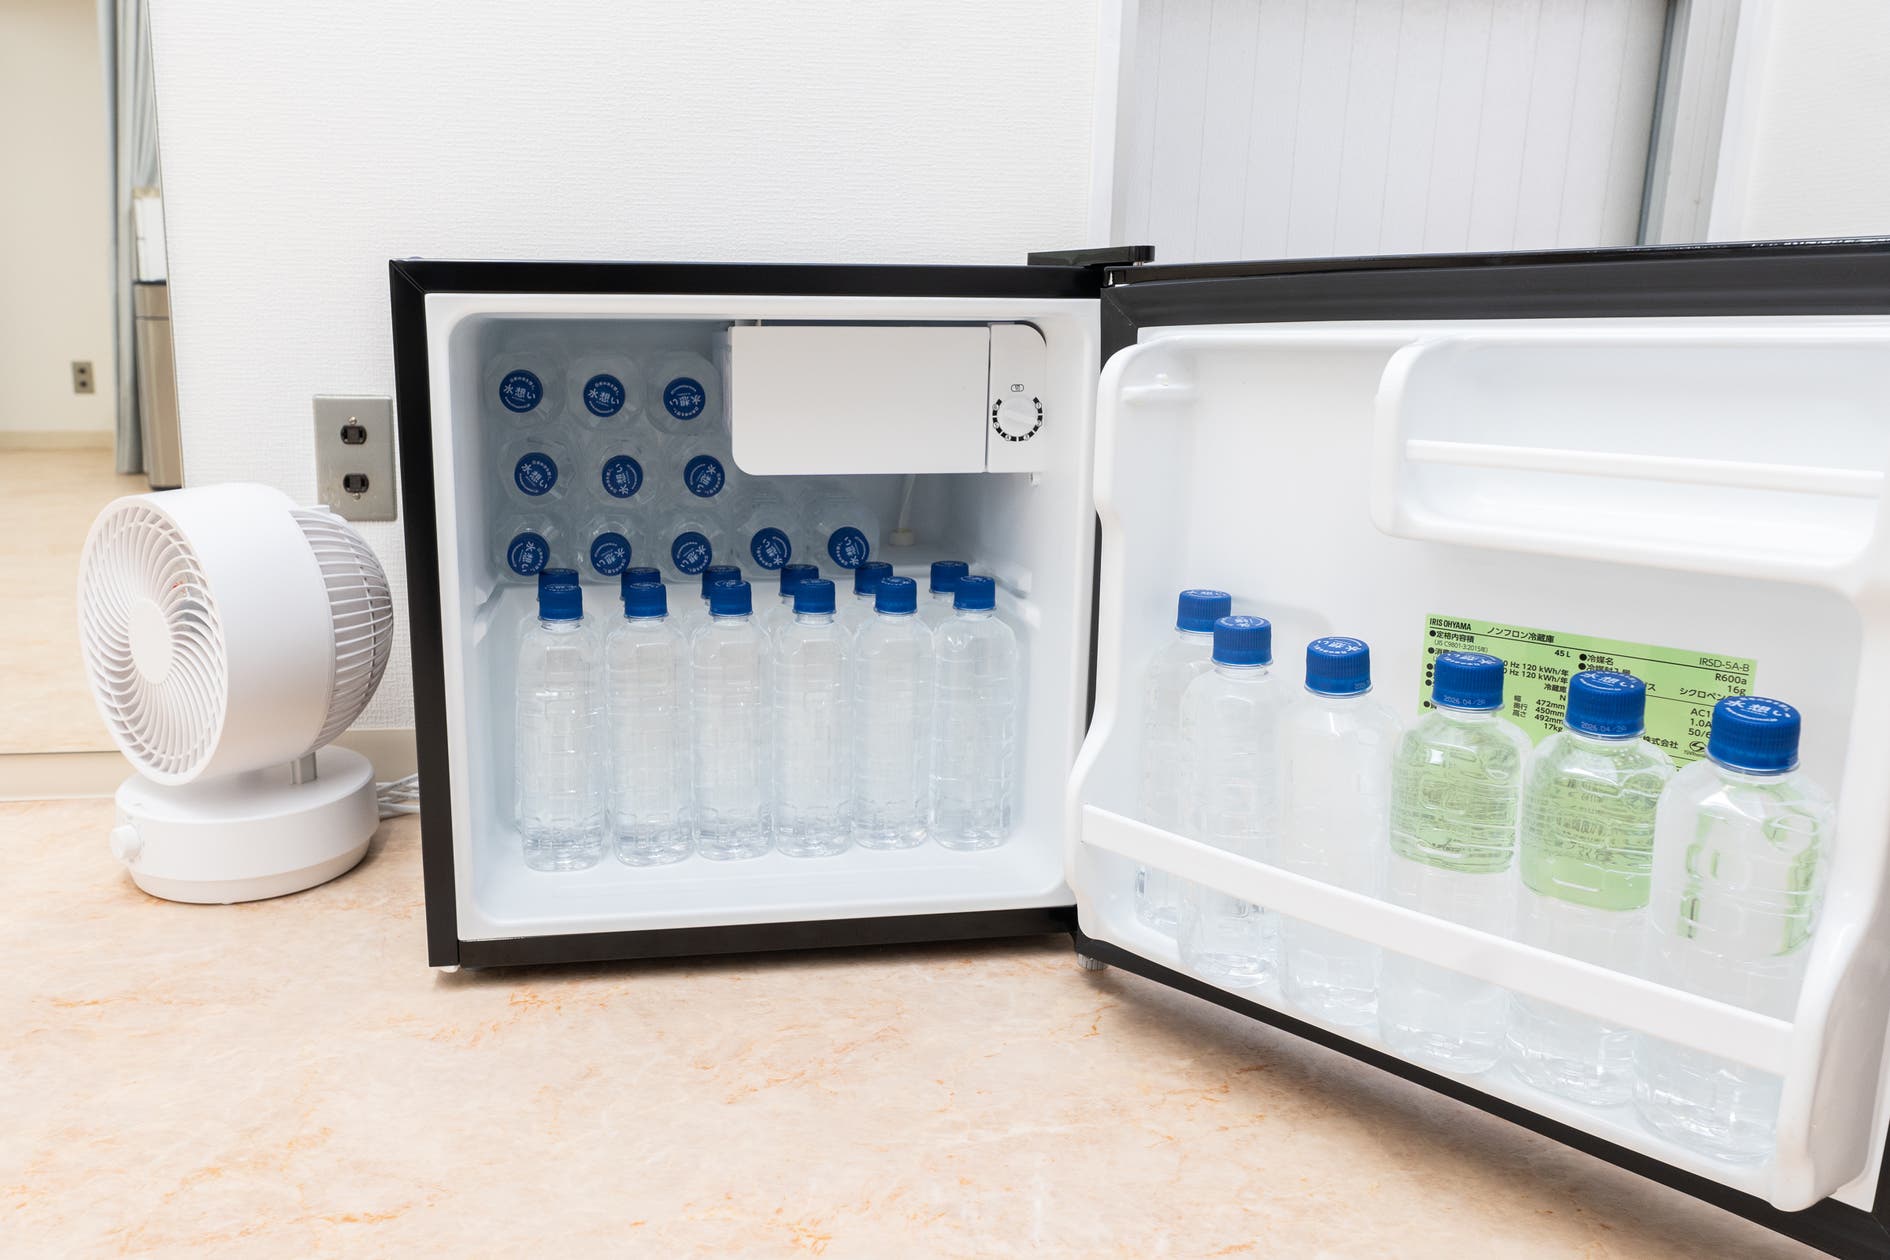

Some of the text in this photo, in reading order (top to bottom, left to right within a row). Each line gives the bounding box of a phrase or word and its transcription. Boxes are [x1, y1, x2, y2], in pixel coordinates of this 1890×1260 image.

[1429, 618, 1472, 631] IRIS OHYAMA
[1436, 631, 1475, 643] 定格内容積
[1487, 627, 1555, 643] ノンフロン冷蔵庫
[1587, 654, 1614, 666] 冷媒名
[1699, 657, 1750, 672] IRSD-5A-B
[1523, 663, 1537, 671] 120
[1522, 671, 1536, 679] 120
[1715, 673, 1747, 685] R600a
[1680, 687, 1725, 701] シクロペン
[1728, 685, 1746, 697] 16g
[1536, 699, 1565, 710] 472mm
[1724, 700, 1791, 718] 水想い
[1535, 707, 1564, 717] 450mm
[1690, 707, 1711, 718] AC1
[1534, 714, 1563, 724] 492mm
[1543, 723, 1563, 733] 17kg
[1688, 728, 1711, 739] 50/6
